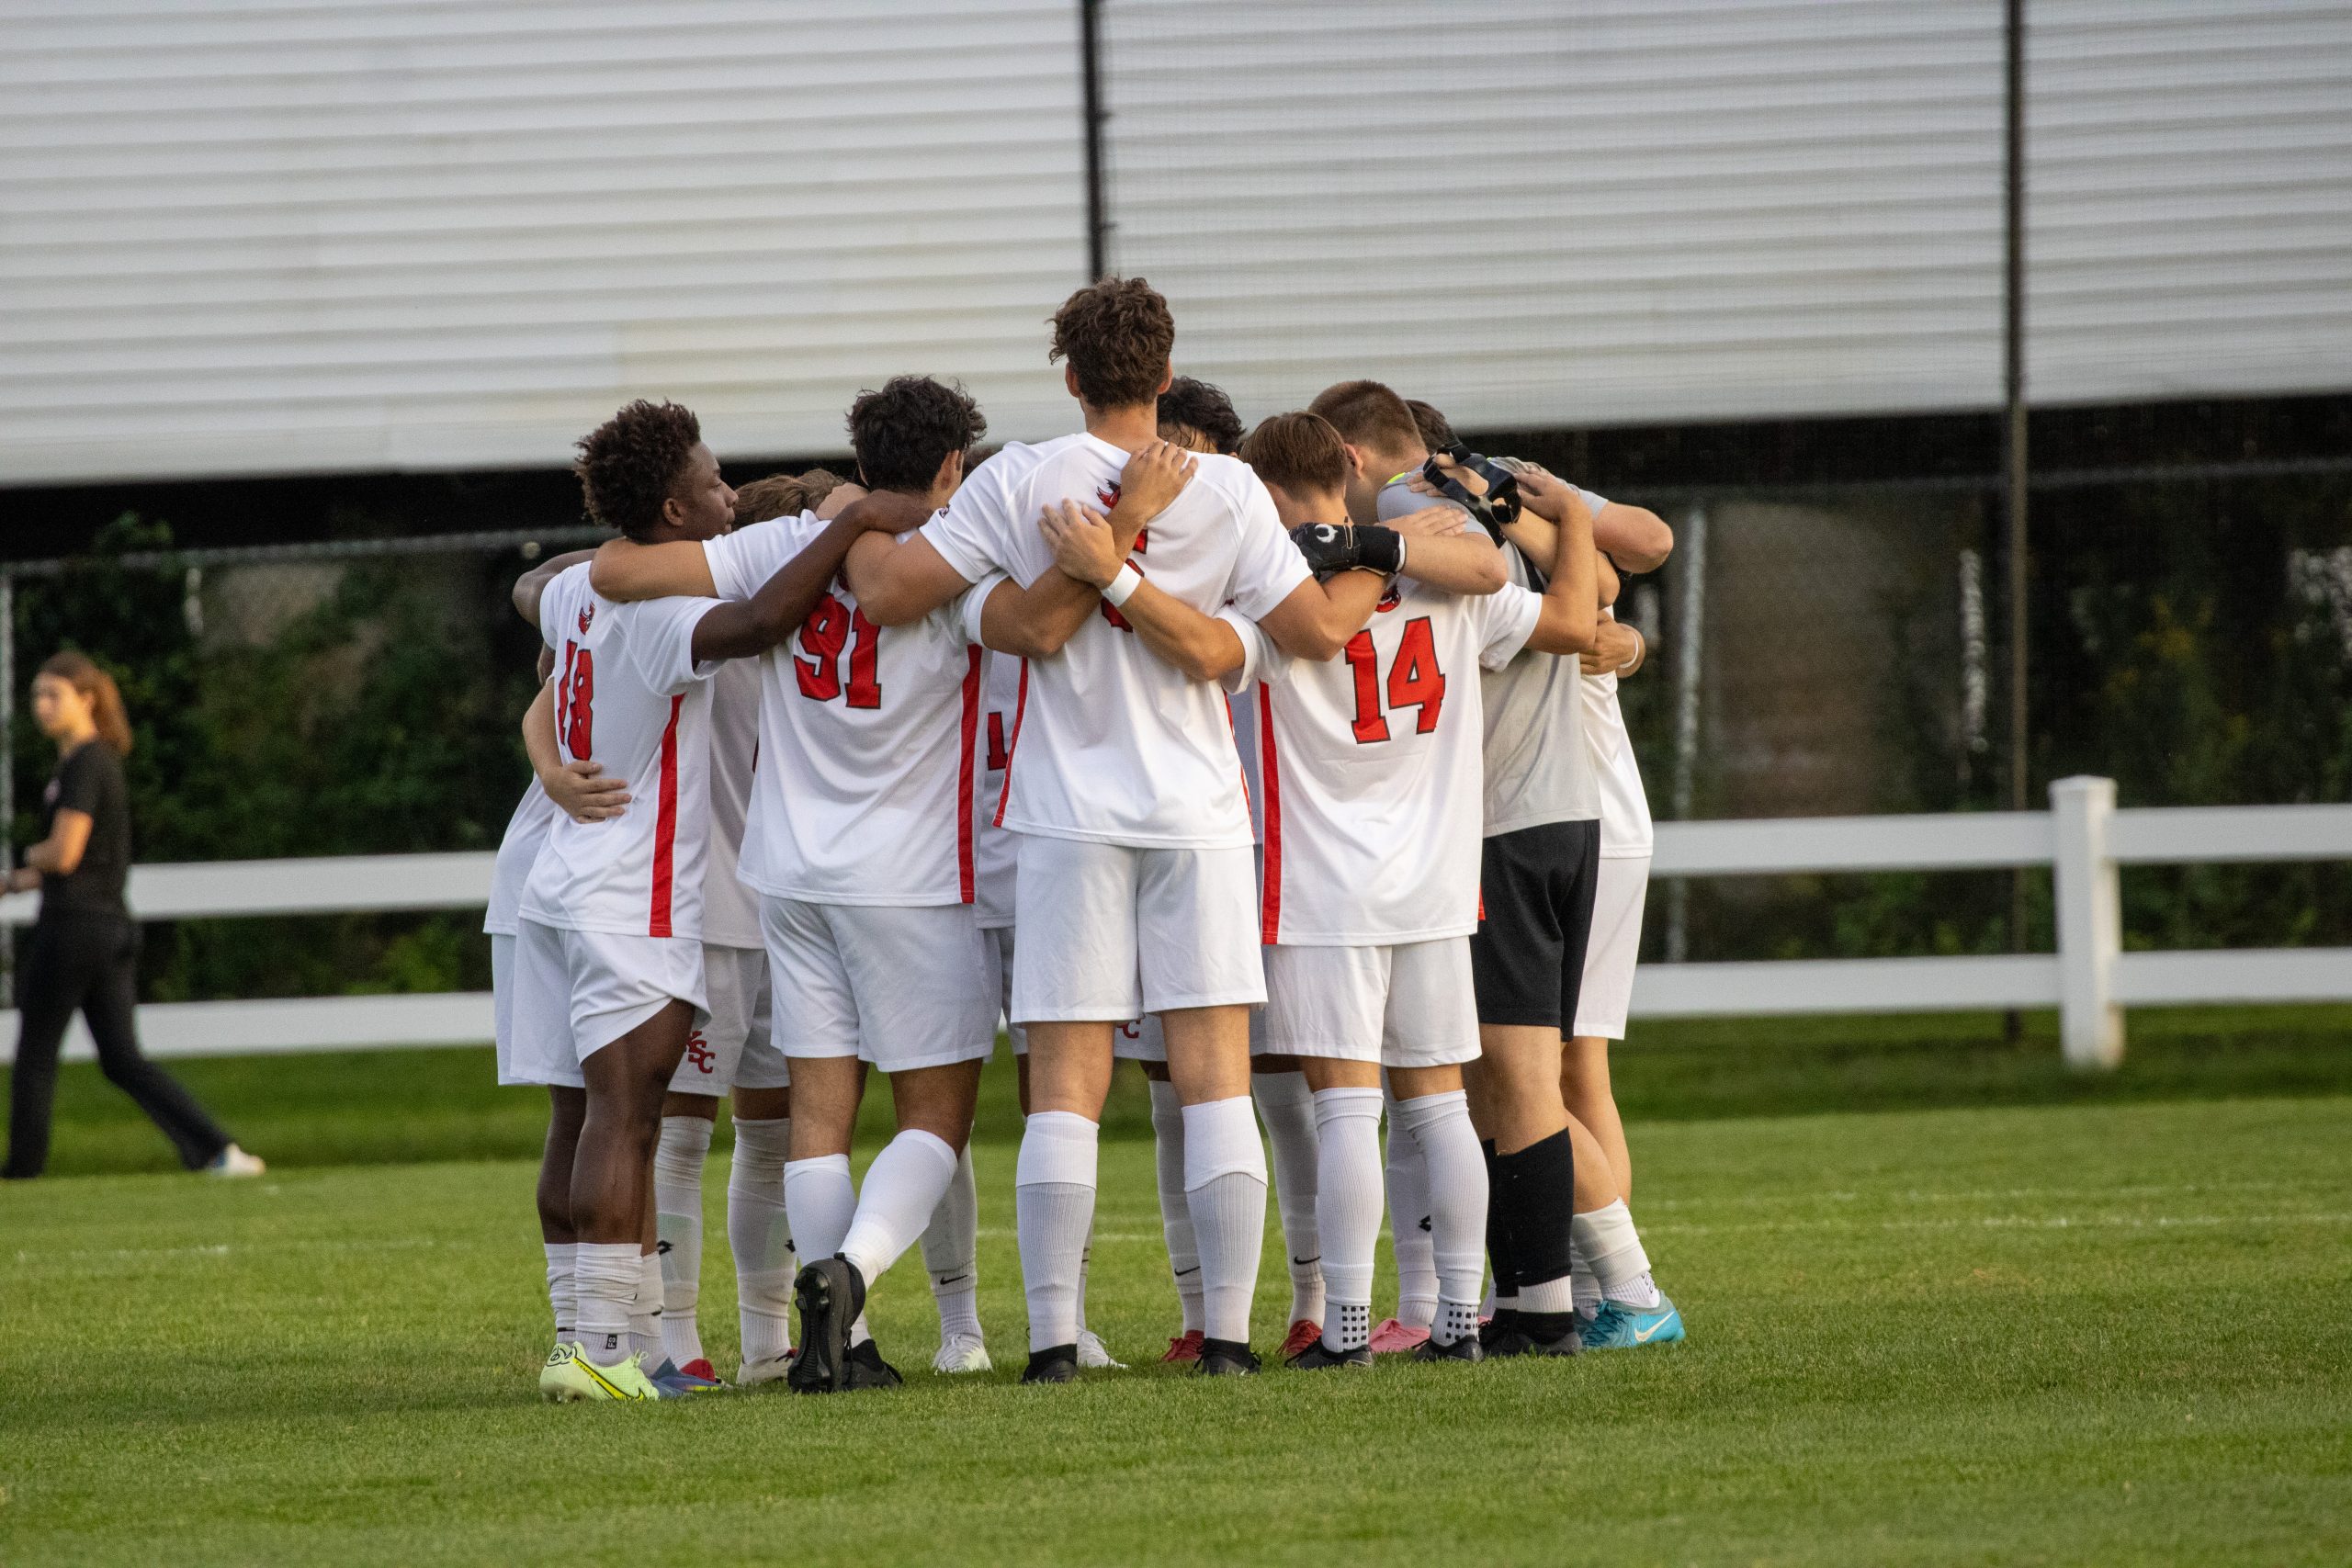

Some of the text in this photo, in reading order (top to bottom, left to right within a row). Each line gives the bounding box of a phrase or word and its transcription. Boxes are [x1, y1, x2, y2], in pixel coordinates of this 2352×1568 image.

[557, 638, 594, 761] 18
[793, 592, 882, 710] 91
[1344, 615, 1446, 745] 14
